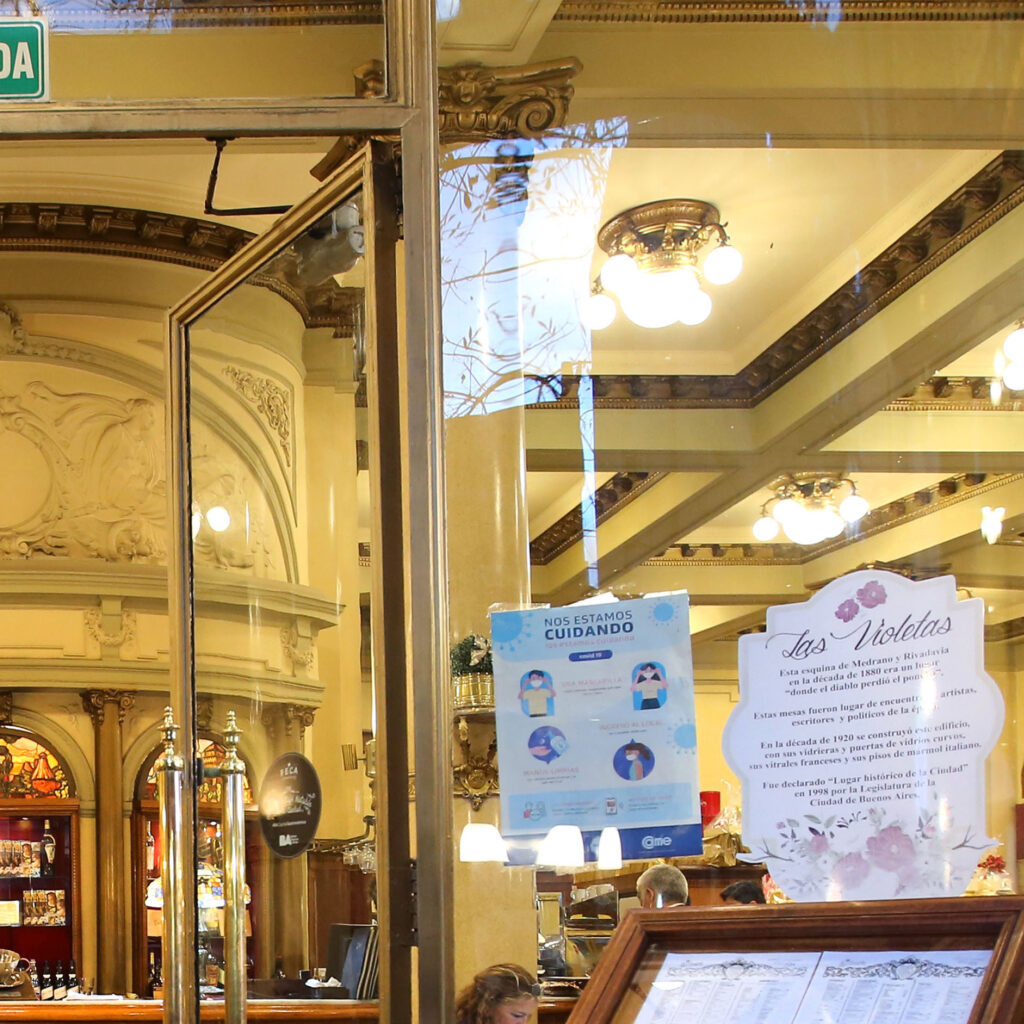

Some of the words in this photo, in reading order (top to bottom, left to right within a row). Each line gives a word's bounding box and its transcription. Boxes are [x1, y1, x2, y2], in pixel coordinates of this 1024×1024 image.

[545, 617, 570, 627] NOS
[575, 610, 632, 624] ESTAMOS
[545, 622, 633, 640] CUIDANDO
[766, 630, 827, 660] Las
[830, 610, 951, 650] Violetas
[802, 665, 836, 674] esquina
[853, 657, 893, 667] Medrano
[904, 647, 949, 660] Rivadavia
[813, 674, 844, 683] década
[861, 668, 881, 677] 1880
[830, 682, 858, 691] diablo
[861, 677, 890, 690] perdió
[893, 675, 900, 683] el
[809, 705, 837, 714] fueron
[840, 702, 864, 711] lugar
[867, 700, 877, 708] de
[880, 696, 920, 706] encuentr
[792, 717, 834, 726] escritores
[888, 707, 898, 716] de
[786, 738, 816, 747] década
[833, 734, 854, 743] 1920
[868, 726, 912, 739] construyó
[766, 760, 798, 769] vitrales
[800, 757, 841, 766] franceses
[869, 752, 891, 762] pisos
[894, 749, 904, 758] de
[945, 742, 982, 752] italiano.
[799, 747, 839, 756] vidrieras
[850, 742, 884, 754] puertas
[886, 740, 896, 748] de
[782, 778, 826, 788] declarado
[864, 772, 903, 781] histórico
[808, 788, 829, 797] 1998
[831, 788, 847, 797] por
[860, 783, 911, 792] Legislatura
[810, 797, 843, 806] Ciudad
[859, 795, 891, 803] Buenos
